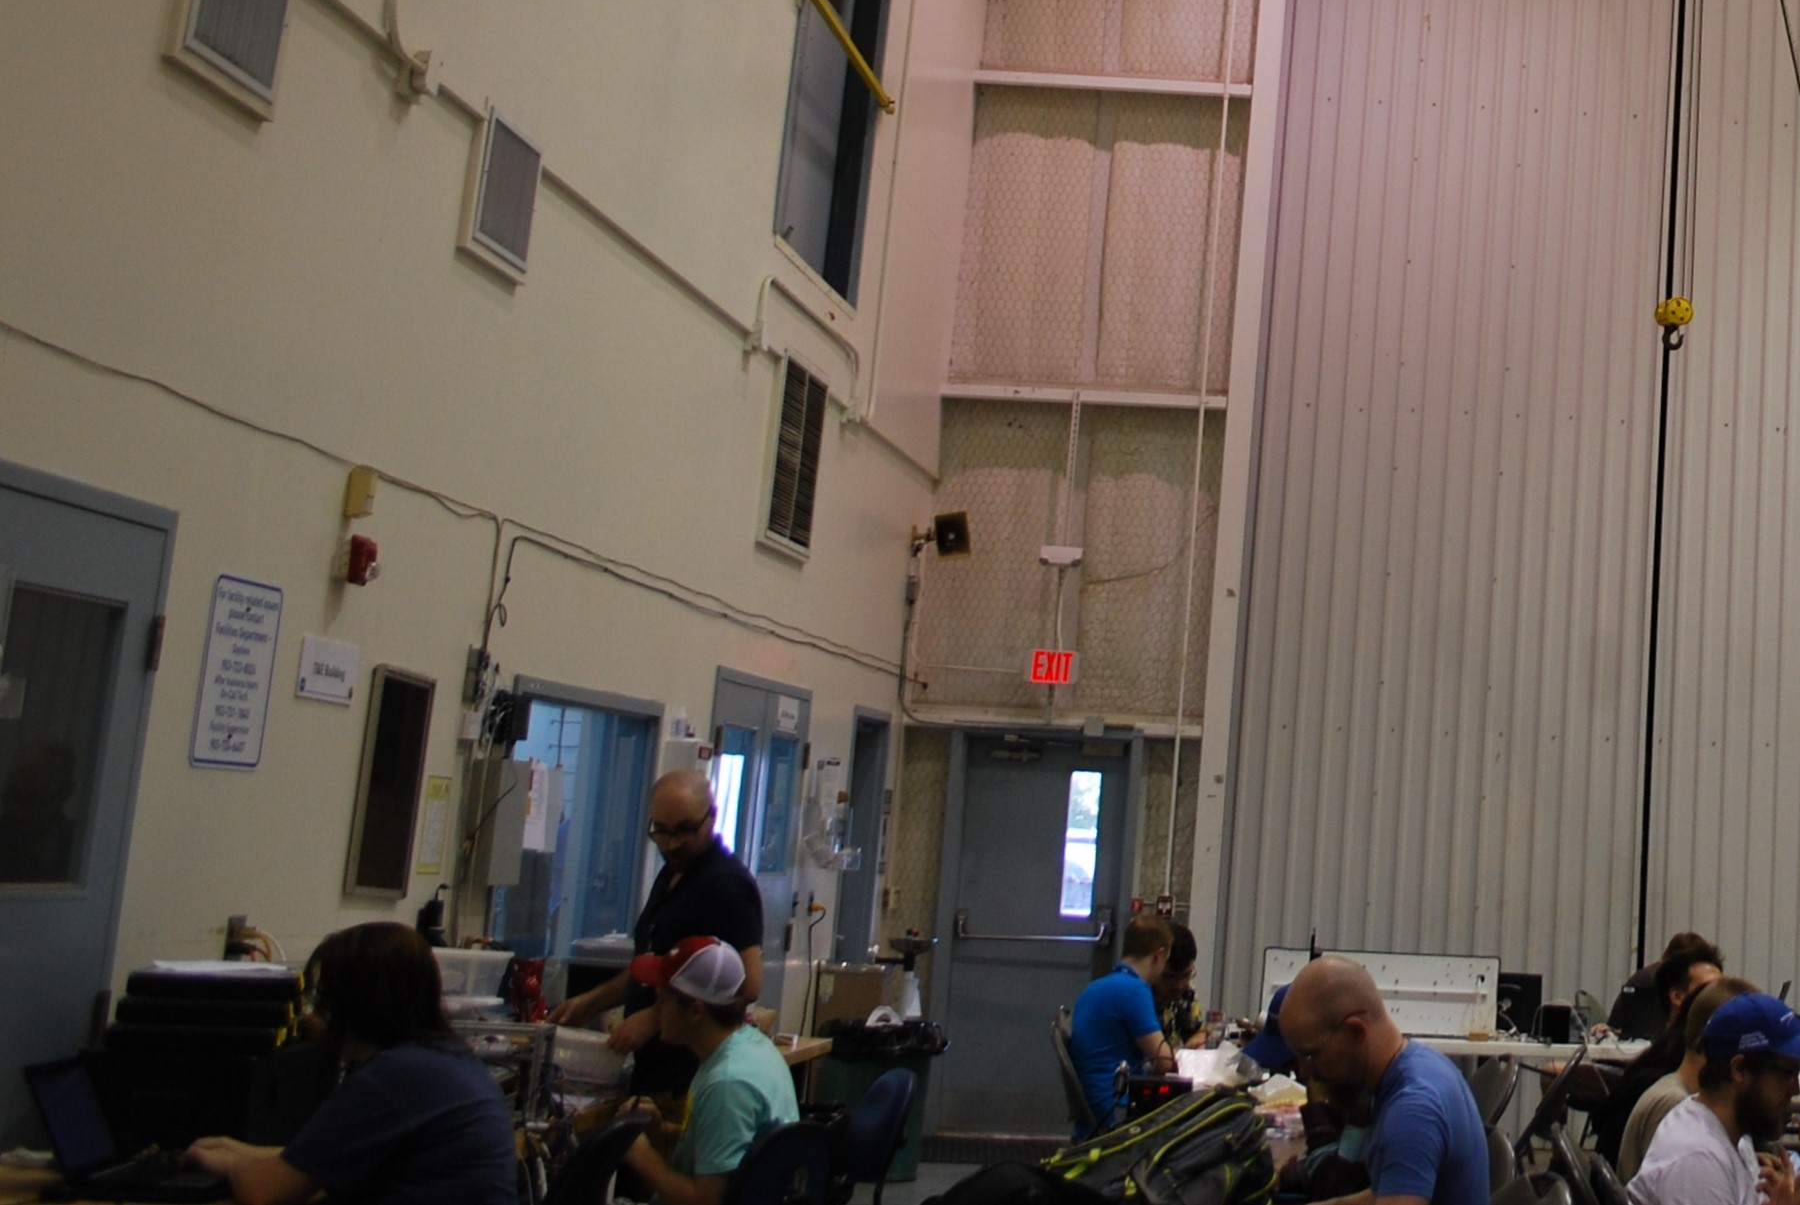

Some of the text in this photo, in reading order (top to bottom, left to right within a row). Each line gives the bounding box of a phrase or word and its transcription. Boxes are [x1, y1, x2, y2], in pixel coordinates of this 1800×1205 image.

[218, 586, 227, 599] For
[228, 589, 244, 604] facility
[245, 596, 263, 607] related
[228, 609, 264, 624] please contact
[216, 621, 268, 642] Facilities Department
[325, 664, 346, 683] Building
[1032, 651, 1073, 683] EXIT
